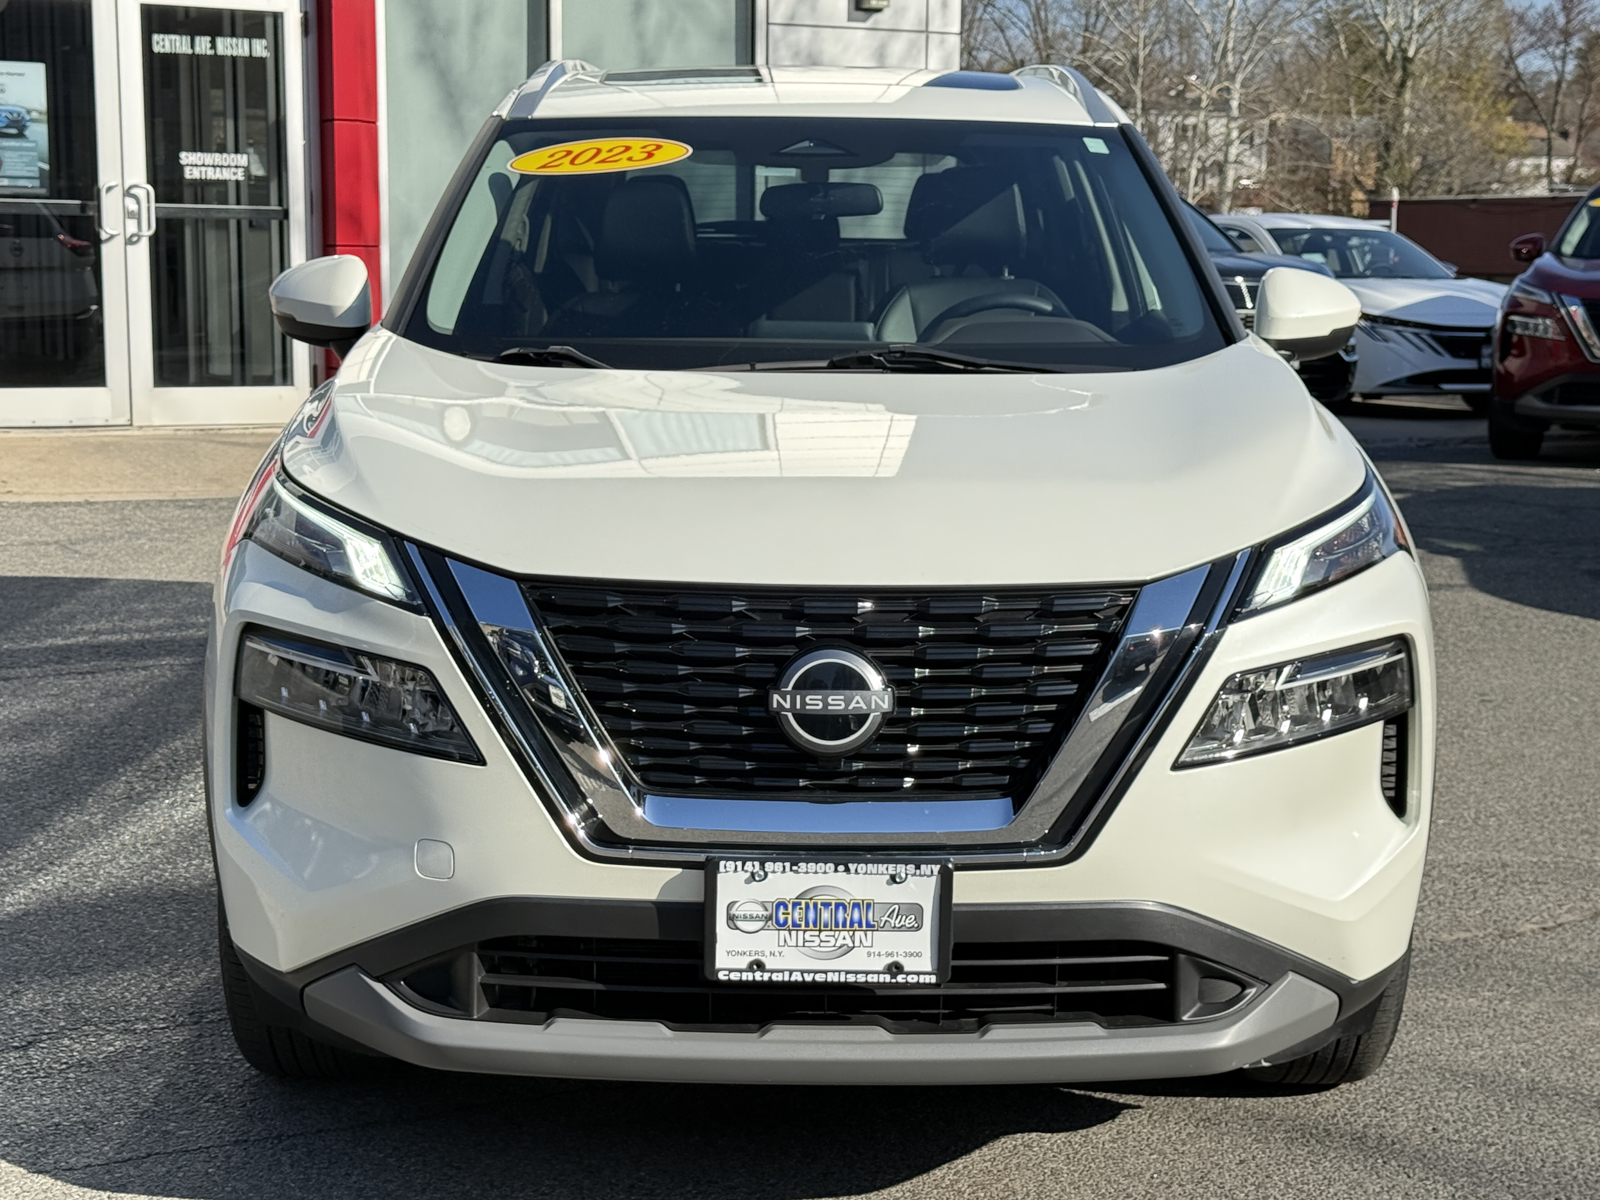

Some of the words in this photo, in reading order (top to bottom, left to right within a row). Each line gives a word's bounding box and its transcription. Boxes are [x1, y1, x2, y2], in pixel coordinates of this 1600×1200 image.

[151, 33, 193, 54] CENTRAL
[194, 35, 215, 55] AVE.
[215, 36, 250, 57] NISSAN
[179, 151, 248, 167] SHOWROOM
[536, 143, 663, 170] 2023
[184, 166, 245, 180] ENTRANCE
[772, 693, 889, 710] NISSAN
[773, 898, 877, 930] CENTRAL
[880, 904, 919, 928] Ave.
[778, 930, 873, 947] NISSAN
[726, 950, 768, 958] YONKERS,
[717, 970, 937, 983] CentralAveNissan.com
